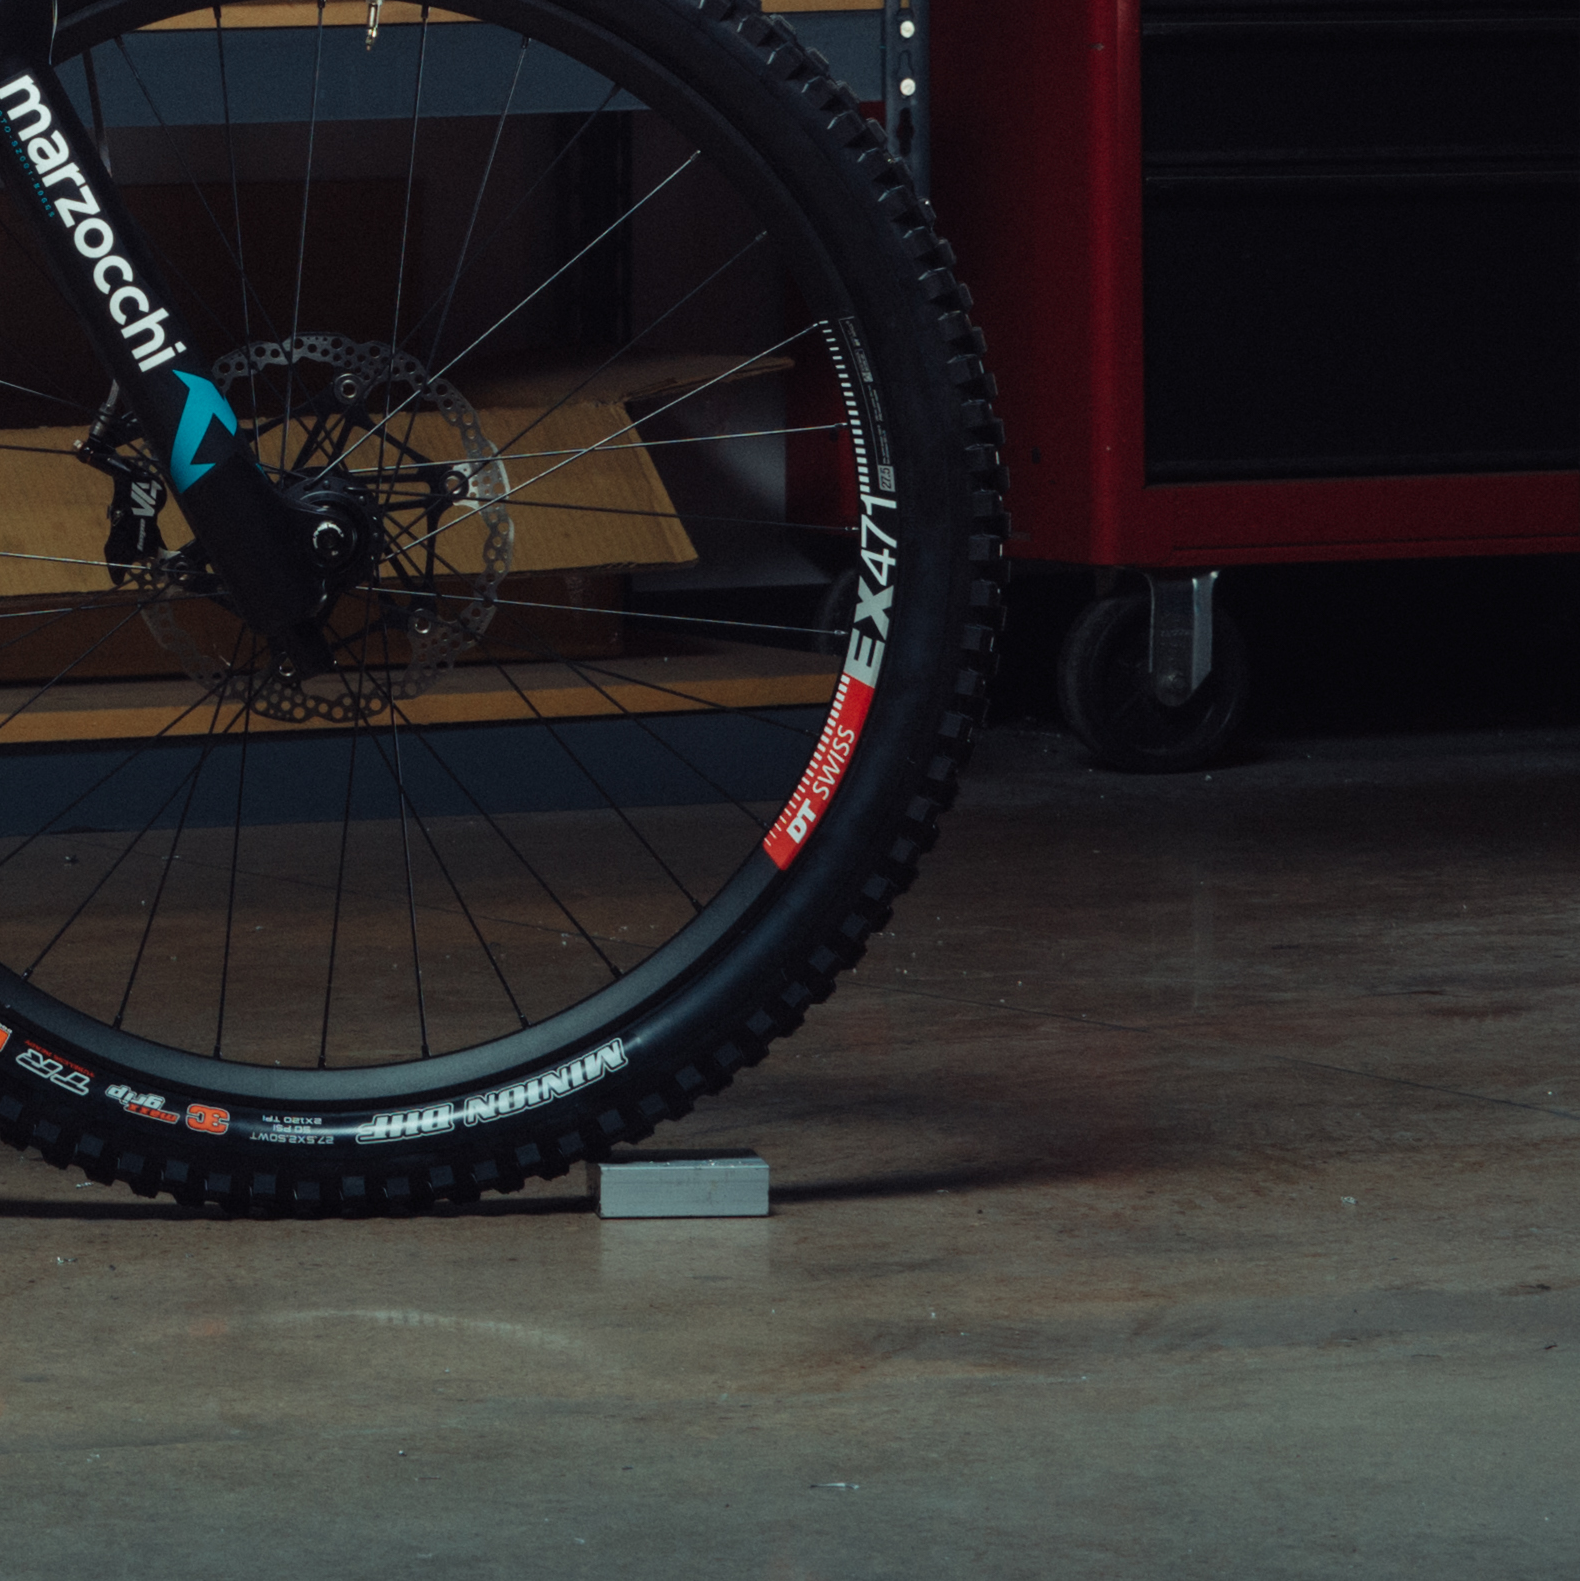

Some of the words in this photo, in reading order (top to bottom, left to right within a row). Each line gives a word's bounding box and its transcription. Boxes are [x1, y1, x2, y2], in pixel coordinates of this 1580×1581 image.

[880, 466, 893, 490] 27.5
[844, 493, 898, 680] EX471
[785, 798, 817, 845] DT
[812, 724, 856, 801] SWISS
[15, 1048, 90, 1096] TR
[463, 1037, 629, 1127] MINION
[105, 1084, 166, 1111] grip
[185, 1103, 231, 1135] 3C
[249, 1131, 335, 1145] 27.5X2.50WT
[355, 1102, 454, 1144] DHF
